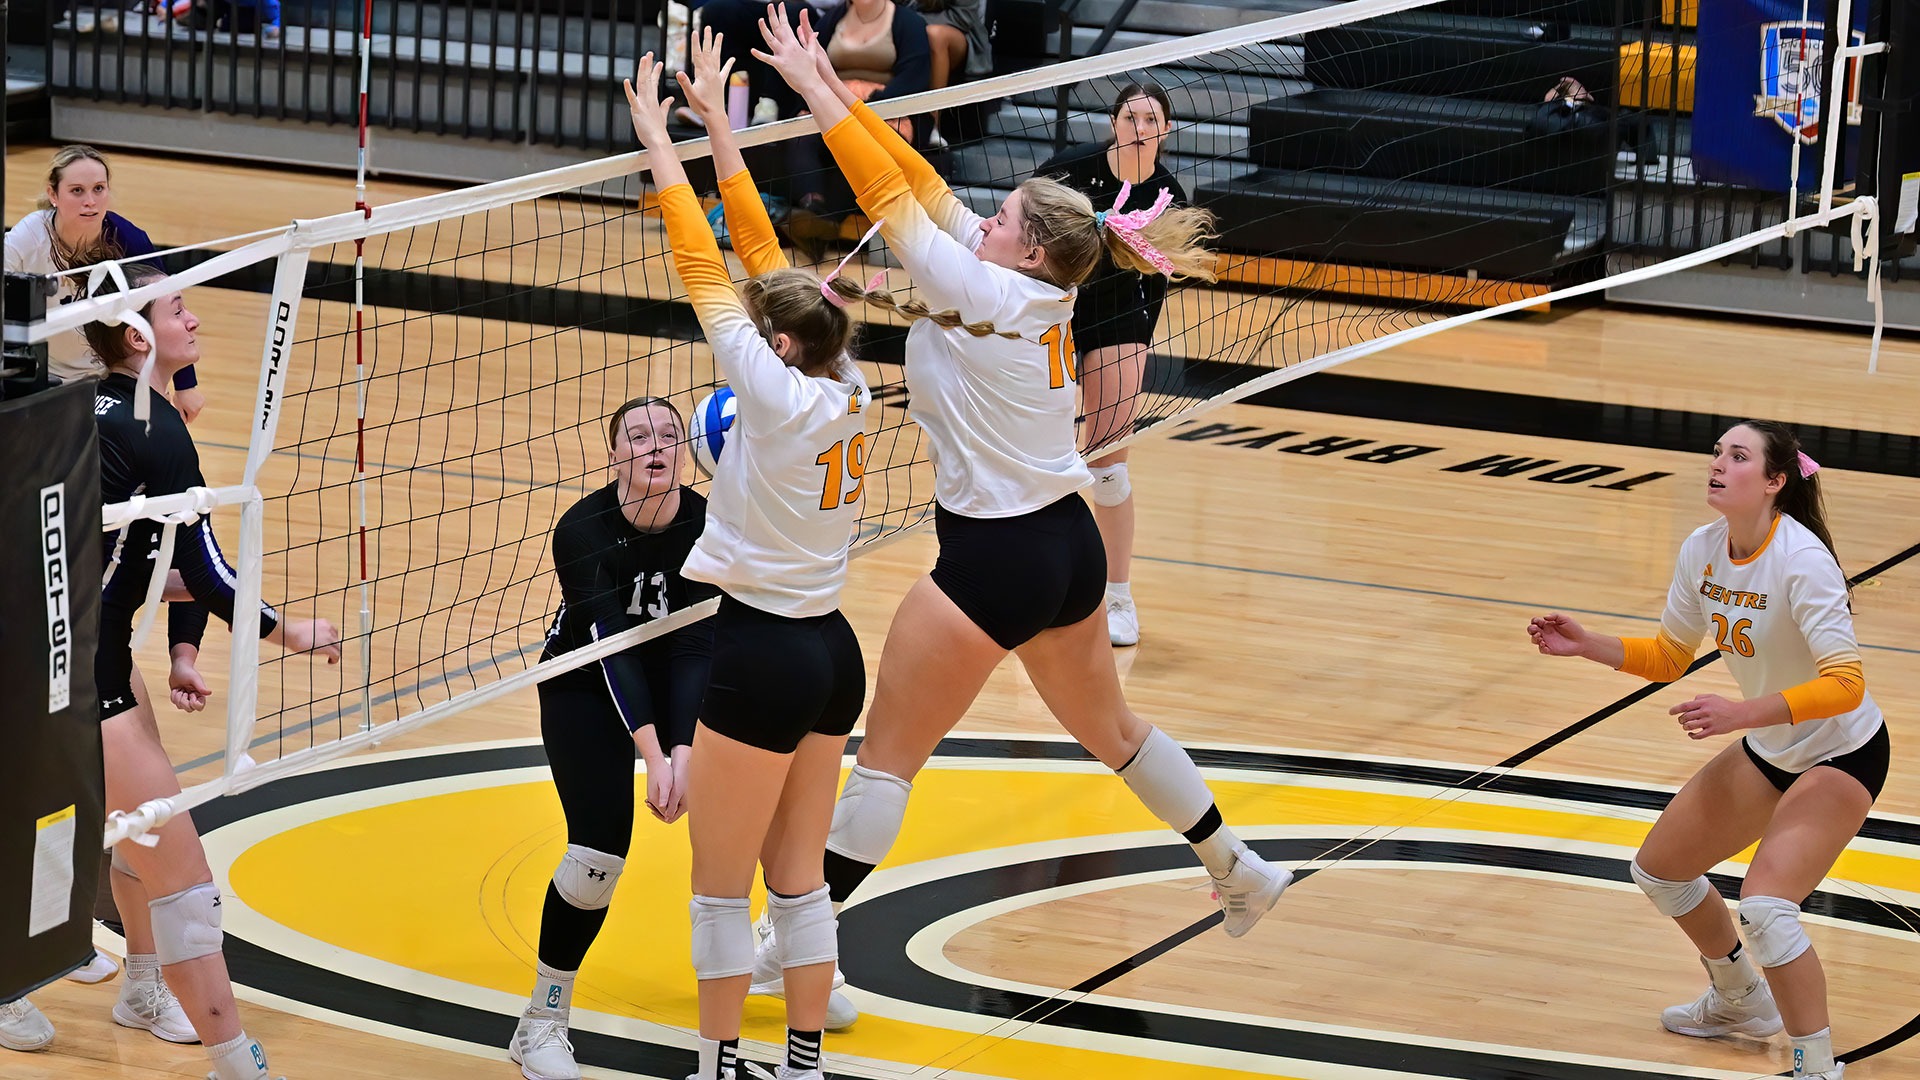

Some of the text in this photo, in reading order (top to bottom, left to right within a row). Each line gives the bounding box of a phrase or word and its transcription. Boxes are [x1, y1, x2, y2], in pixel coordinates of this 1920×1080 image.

[815, 431, 866, 510] 19
[1439, 454, 1676, 491] TOM
[44, 491, 68, 679] PORTER
[626, 571, 669, 619] 13
[1700, 580, 1768, 610] CENTRE
[1711, 612, 1755, 658] 26
